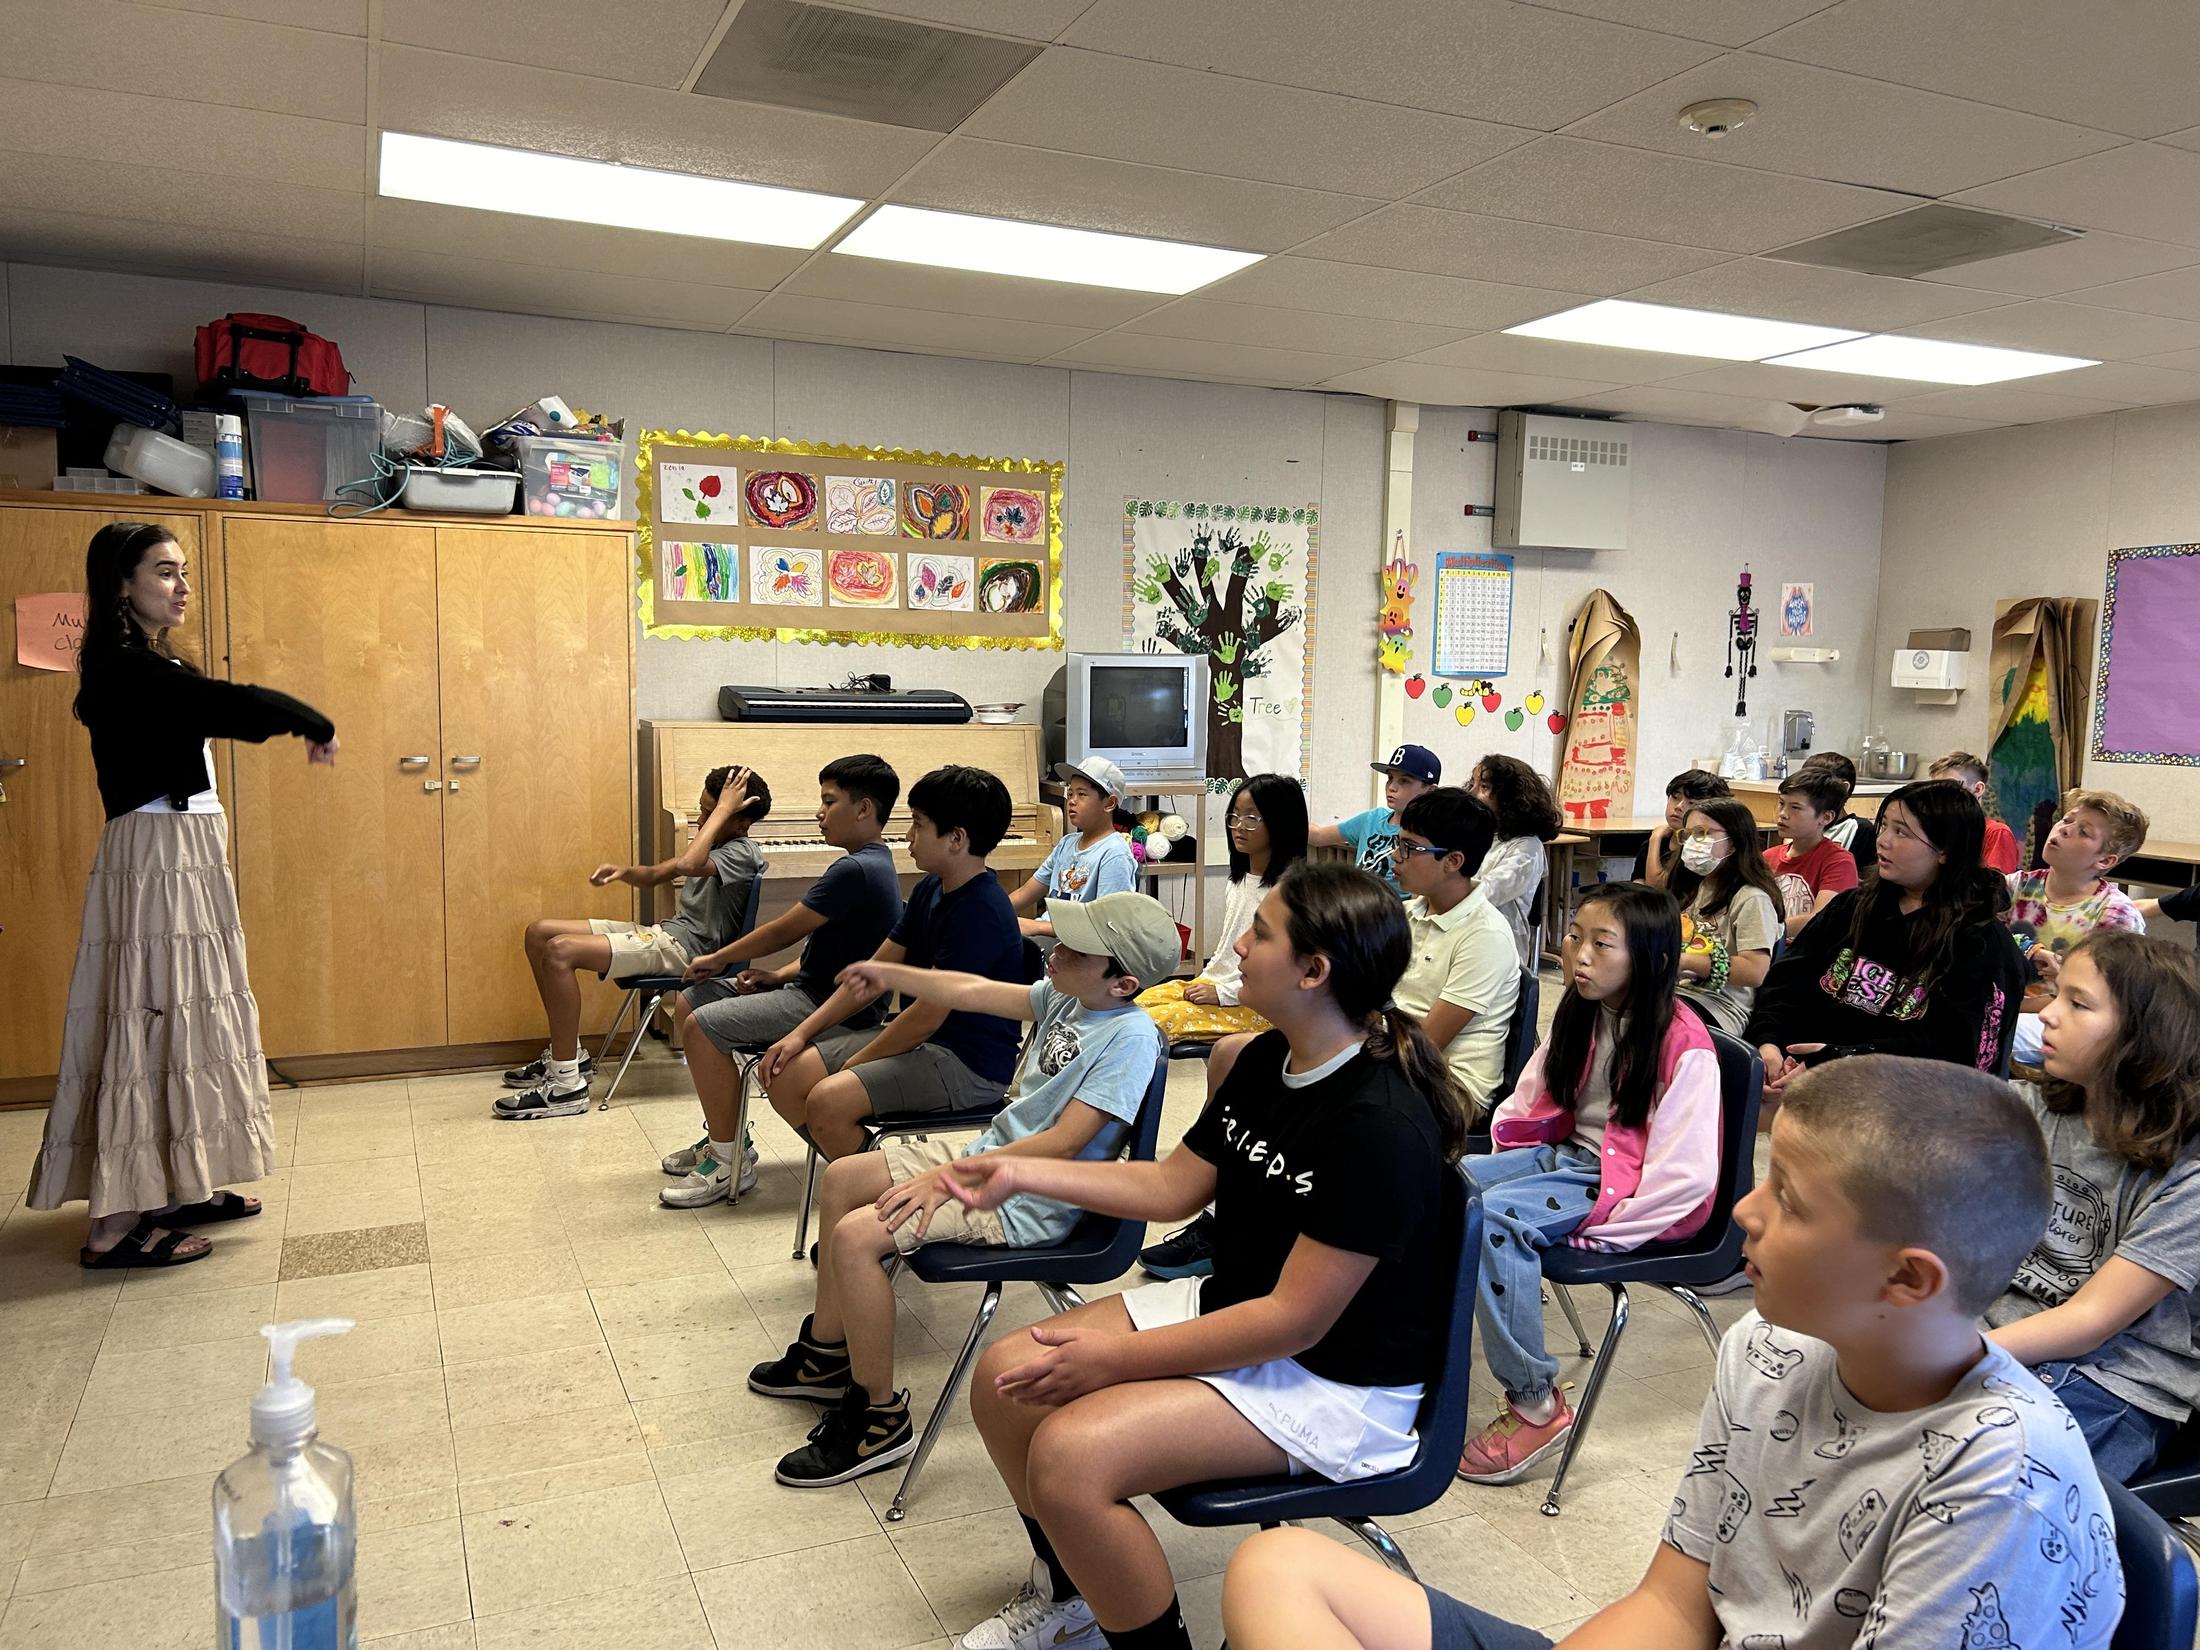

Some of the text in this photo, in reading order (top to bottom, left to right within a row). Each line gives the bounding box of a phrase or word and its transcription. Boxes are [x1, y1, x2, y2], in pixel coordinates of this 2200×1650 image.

[1249, 696, 1282, 715] Tree
[1390, 747, 1406, 765] B
[1280, 1413, 1320, 1450] PUMA
